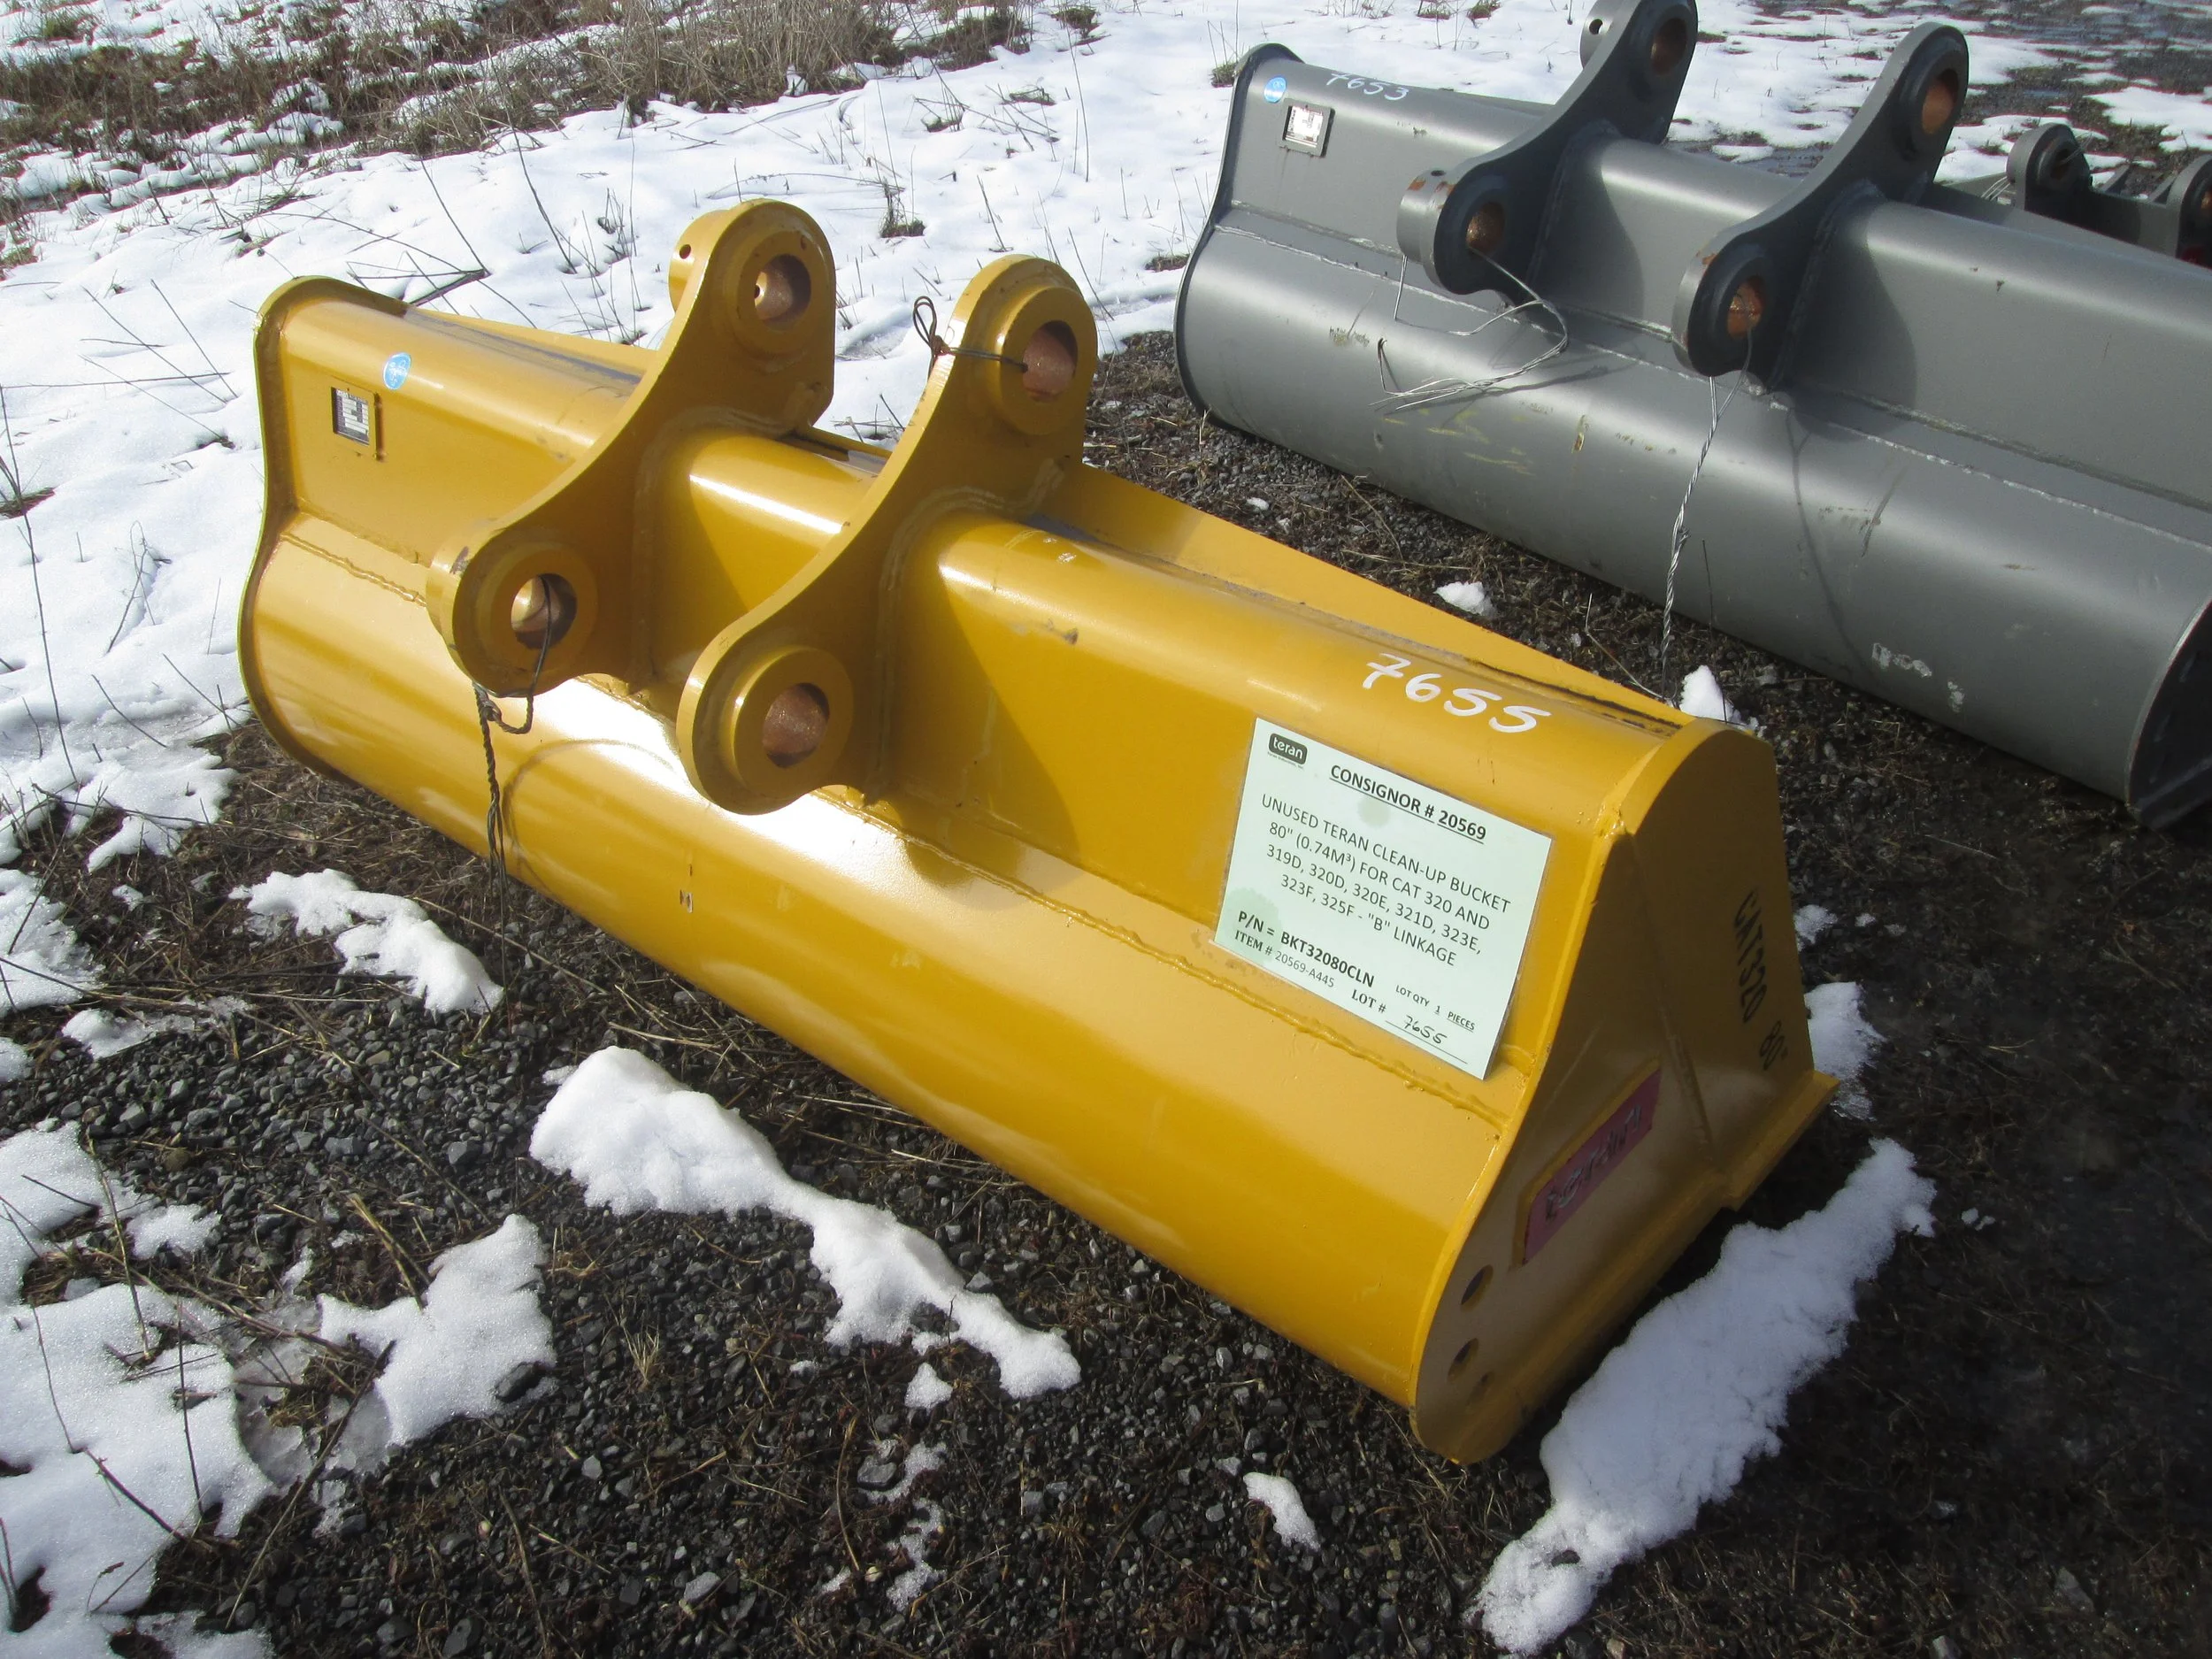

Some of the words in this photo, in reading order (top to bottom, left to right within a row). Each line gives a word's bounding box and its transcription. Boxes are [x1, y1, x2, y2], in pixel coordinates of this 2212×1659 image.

[1326, 73, 1409, 101] 7653
[1363, 653, 1552, 733] 7655
[1273, 736, 1303, 759] teran
[1330, 764, 1421, 814] CONSIGNOR
[1425, 803, 1435, 818] #
[1438, 810, 1486, 841] 20569
[1262, 794, 1319, 829] UNUSED
[1323, 819, 1370, 852] TERAN
[1372, 843, 1447, 884] CLEAN-UP
[1449, 877, 1511, 913] BUCKET
[1269, 821, 1294, 839] 80"
[1359, 862, 1388, 886] FOR
[1392, 877, 1422, 899] CAT
[1424, 891, 1453, 913] 320
[1455, 906, 1490, 930] AND
[1266, 844, 1304, 874] 319D,
[1309, 864, 1348, 894] 320D,
[1352, 883, 1390, 913] 320E,
[1394, 902, 1436, 934] 321D,
[1441, 924, 1482, 956] 323E,
[1280, 874, 1316, 903] 323F,
[1320, 893, 1356, 918] 325F
[1368, 912, 1391, 932] "B"
[1394, 926, 1457, 966] LINKAGE
[1234, 930, 1263, 952] ITEM
[1264, 945, 1273, 956] #
[1275, 950, 1335, 988] 20569-A445
[1238, 910, 1264, 933] P/N
[1266, 927, 1275, 936] =
[1280, 931, 1375, 988] BKT32080CLN
[1351, 988, 1377, 1009] LOT
[1378, 1002, 1386, 1014] #
[1395, 984, 1412, 999] LOT
[1412, 993, 1430, 1008] QTY
[1434, 1005, 1441, 1015] 1
[1447, 1010, 1476, 1032] PIECES
[1403, 1014, 1448, 1045] 7655
